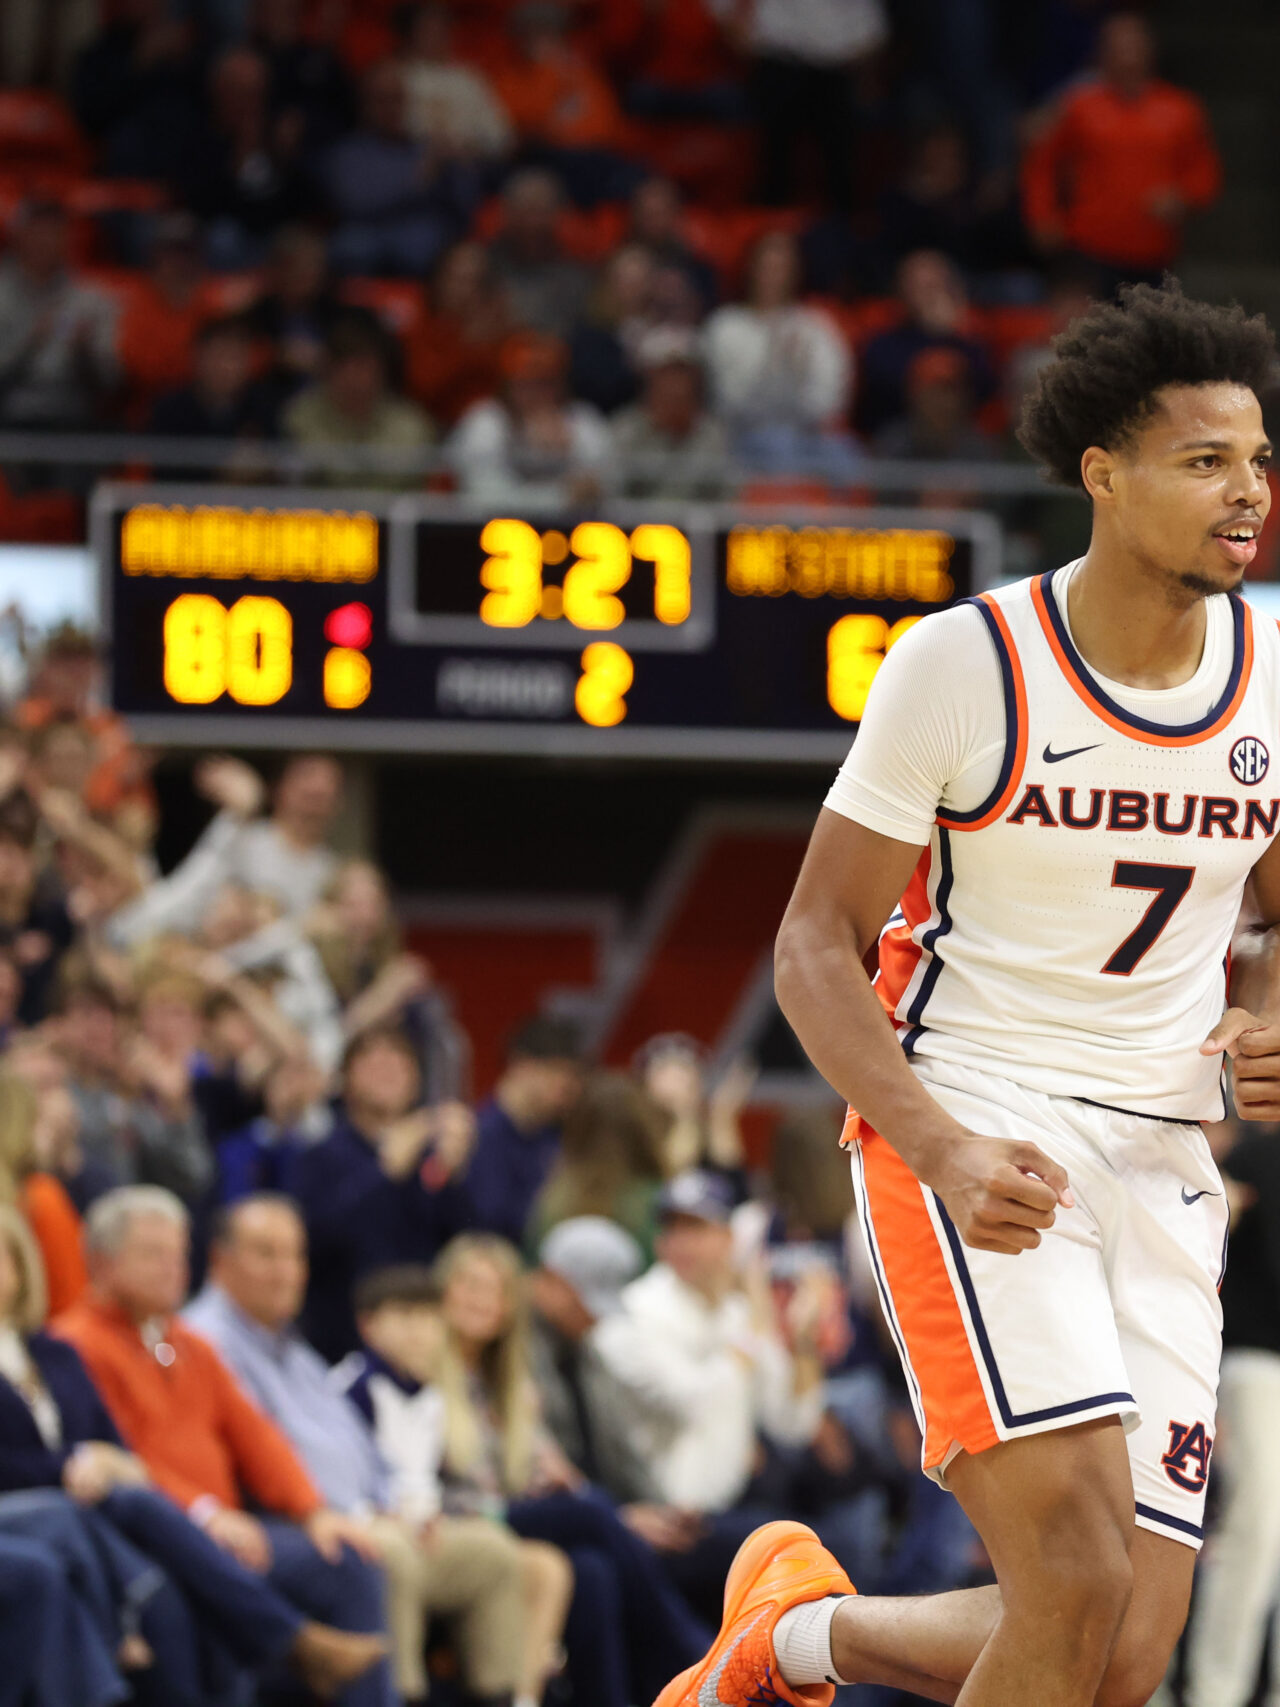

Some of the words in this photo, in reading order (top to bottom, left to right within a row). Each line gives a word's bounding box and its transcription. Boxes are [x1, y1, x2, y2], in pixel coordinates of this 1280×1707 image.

[480, 518, 691, 630] 3:27
[164, 593, 293, 705] 80
[827, 614, 926, 722] 6
[1230, 737, 1269, 785] SEC
[1100, 860, 1196, 976] 7
